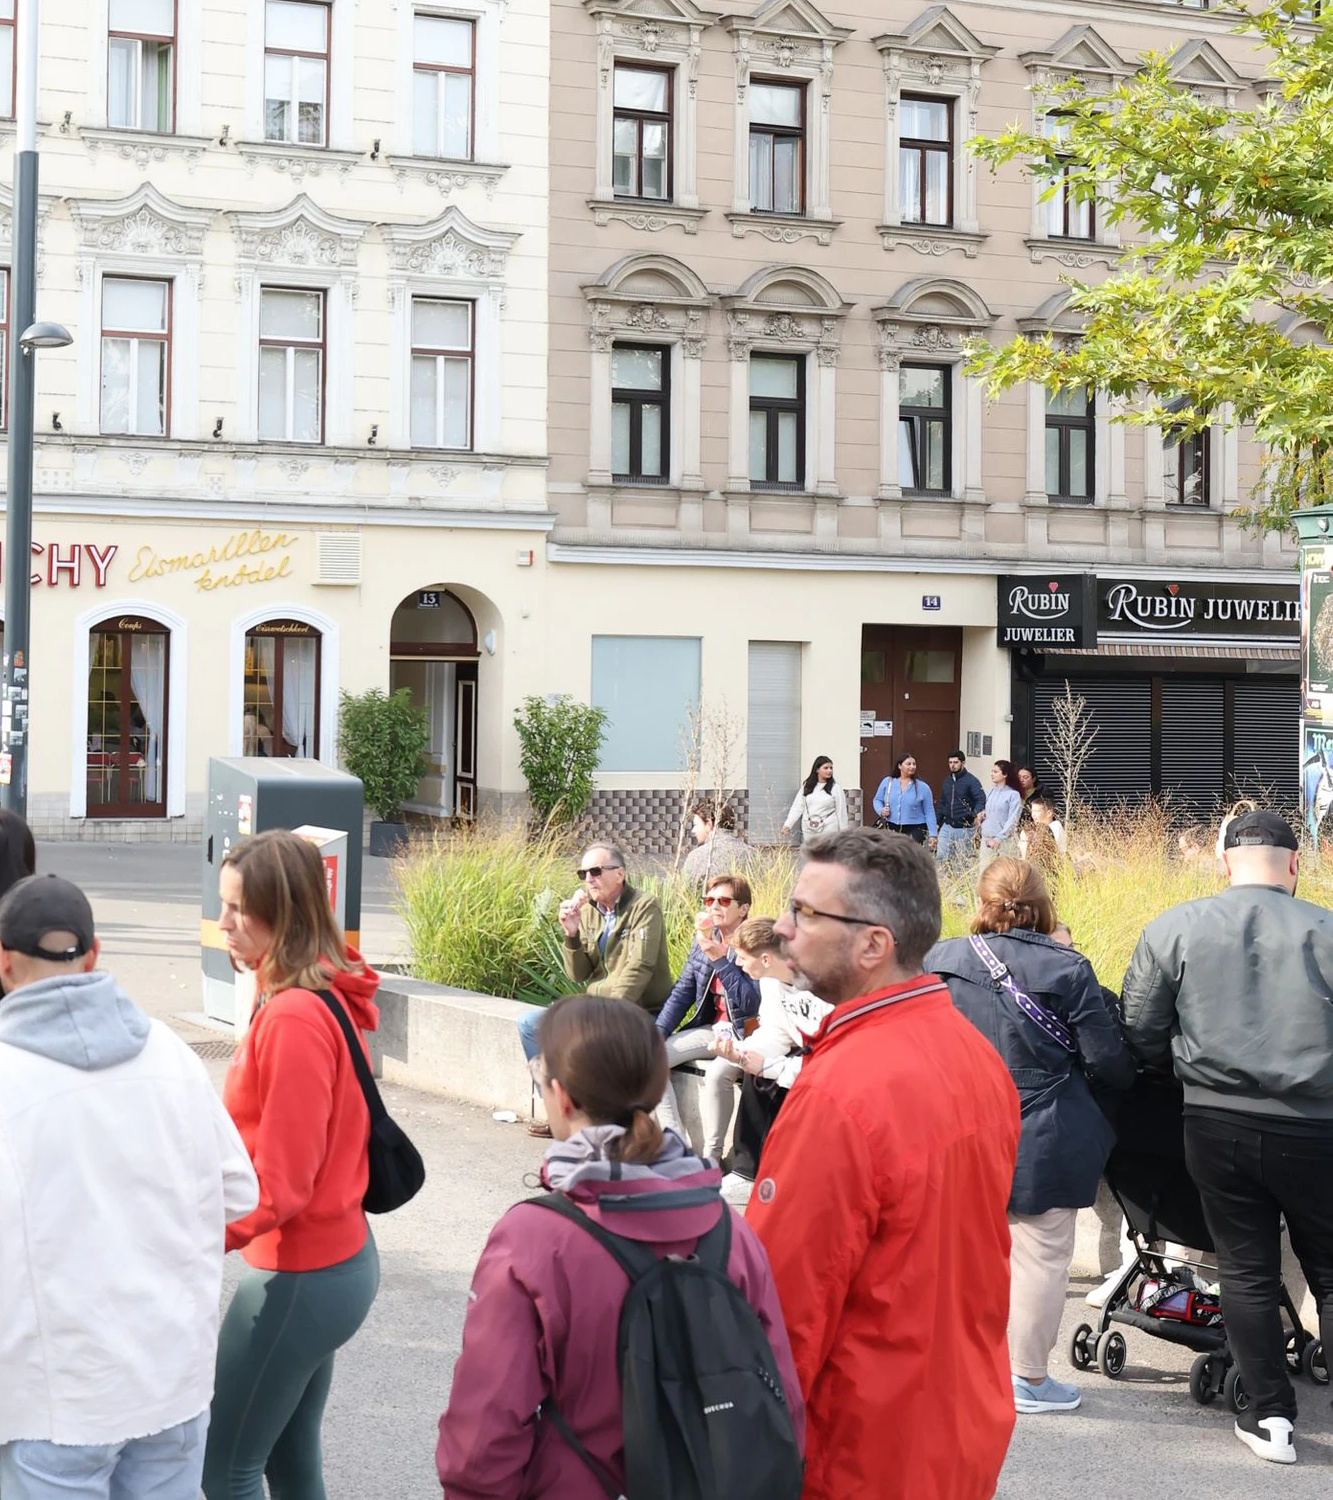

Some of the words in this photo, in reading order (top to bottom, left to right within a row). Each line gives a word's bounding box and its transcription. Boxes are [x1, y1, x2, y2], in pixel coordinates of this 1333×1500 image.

[423, 593, 436, 604] 13
[924, 596, 938, 606] 14
[1009, 586, 1070, 620] RUBIN
[1108, 584, 1197, 629] RUBIN
[1004, 627, 1076, 642] JUWELIER
